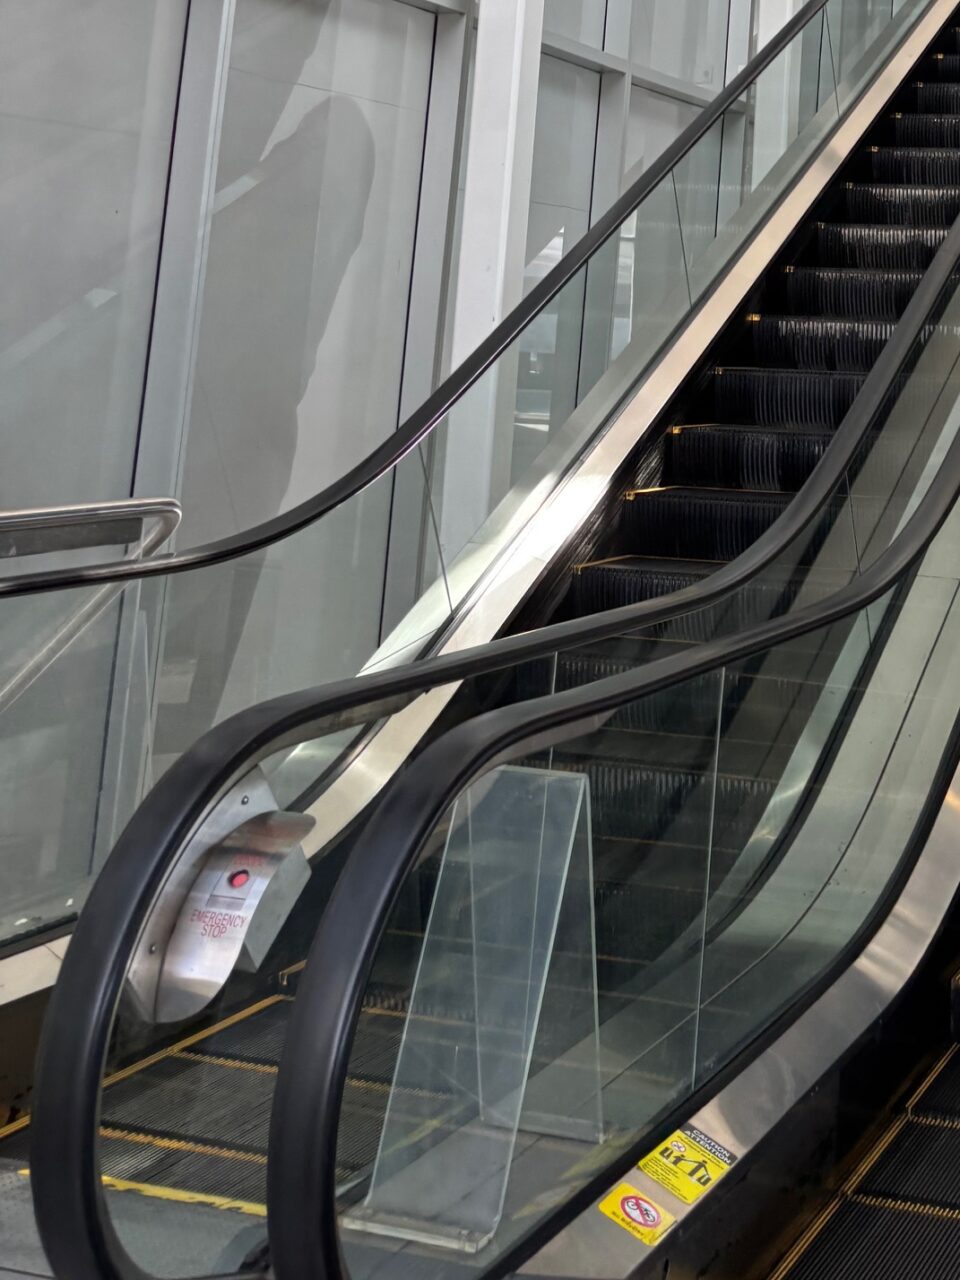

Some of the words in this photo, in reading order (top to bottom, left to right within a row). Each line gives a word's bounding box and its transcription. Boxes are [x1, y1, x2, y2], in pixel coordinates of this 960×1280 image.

[190, 909, 247, 929] EMERGENCY
[201, 923, 228, 938] STOP
[684, 1130, 731, 1164] ATTENTION
[692, 1129, 731, 1158] CAUTION
